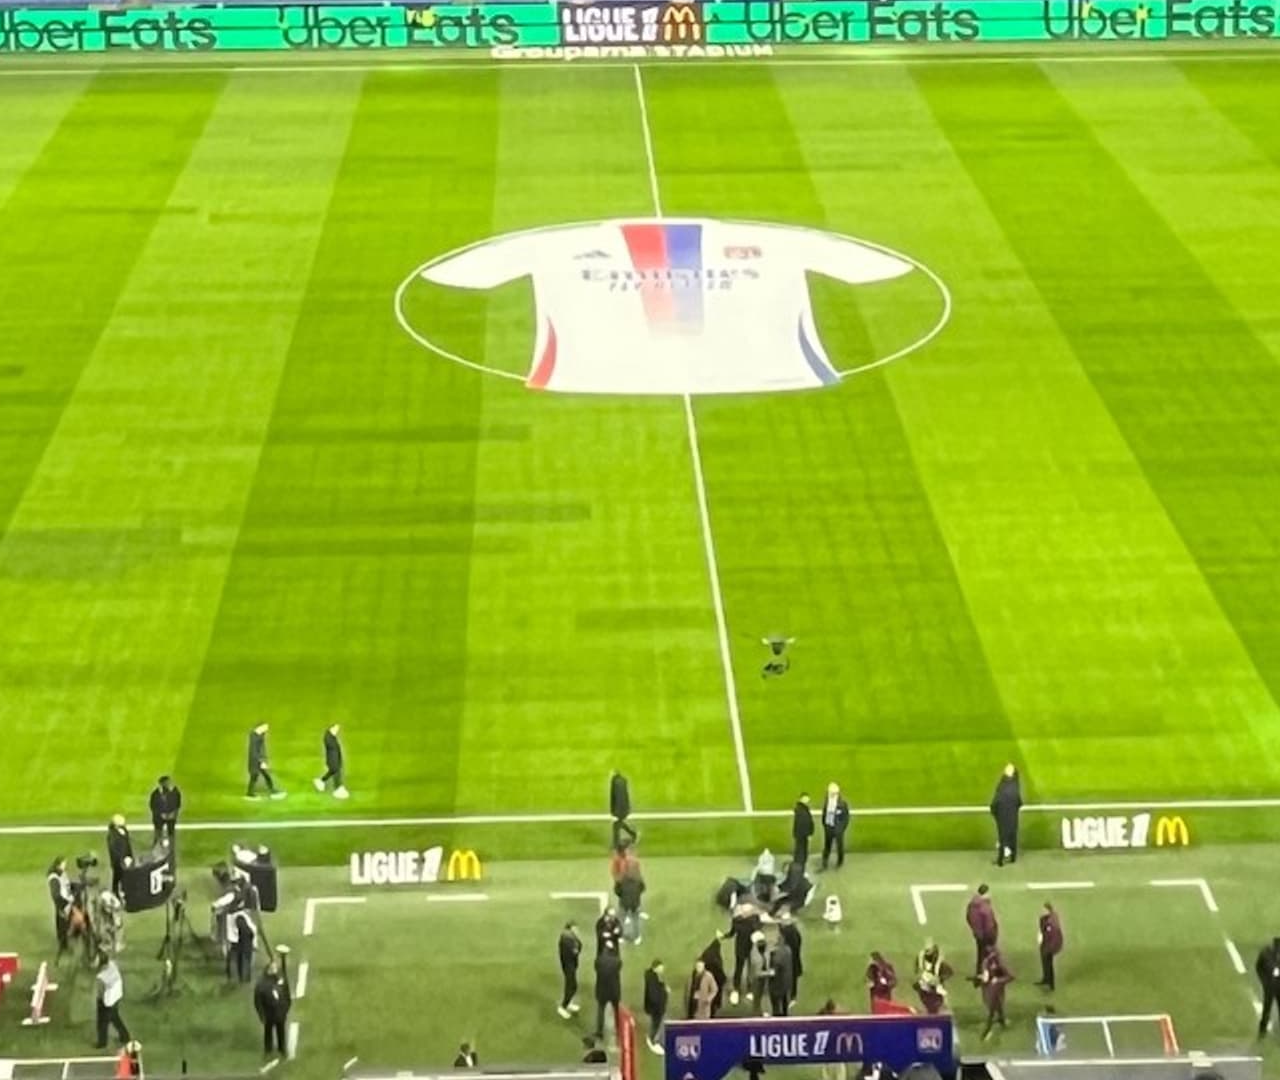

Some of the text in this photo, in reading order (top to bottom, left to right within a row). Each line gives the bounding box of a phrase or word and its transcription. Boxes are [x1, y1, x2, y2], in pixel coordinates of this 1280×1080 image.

[98, 8, 218, 51] Eats
[278, 4, 520, 49] Uber Eats
[562, 6, 640, 42] LIGUE
[744, 0, 980, 41] Uber Eats
[1062, 816, 1129, 849] LIGUE
[350, 852, 419, 885] LIGUE
[749, 1033, 808, 1058] LIGUE
